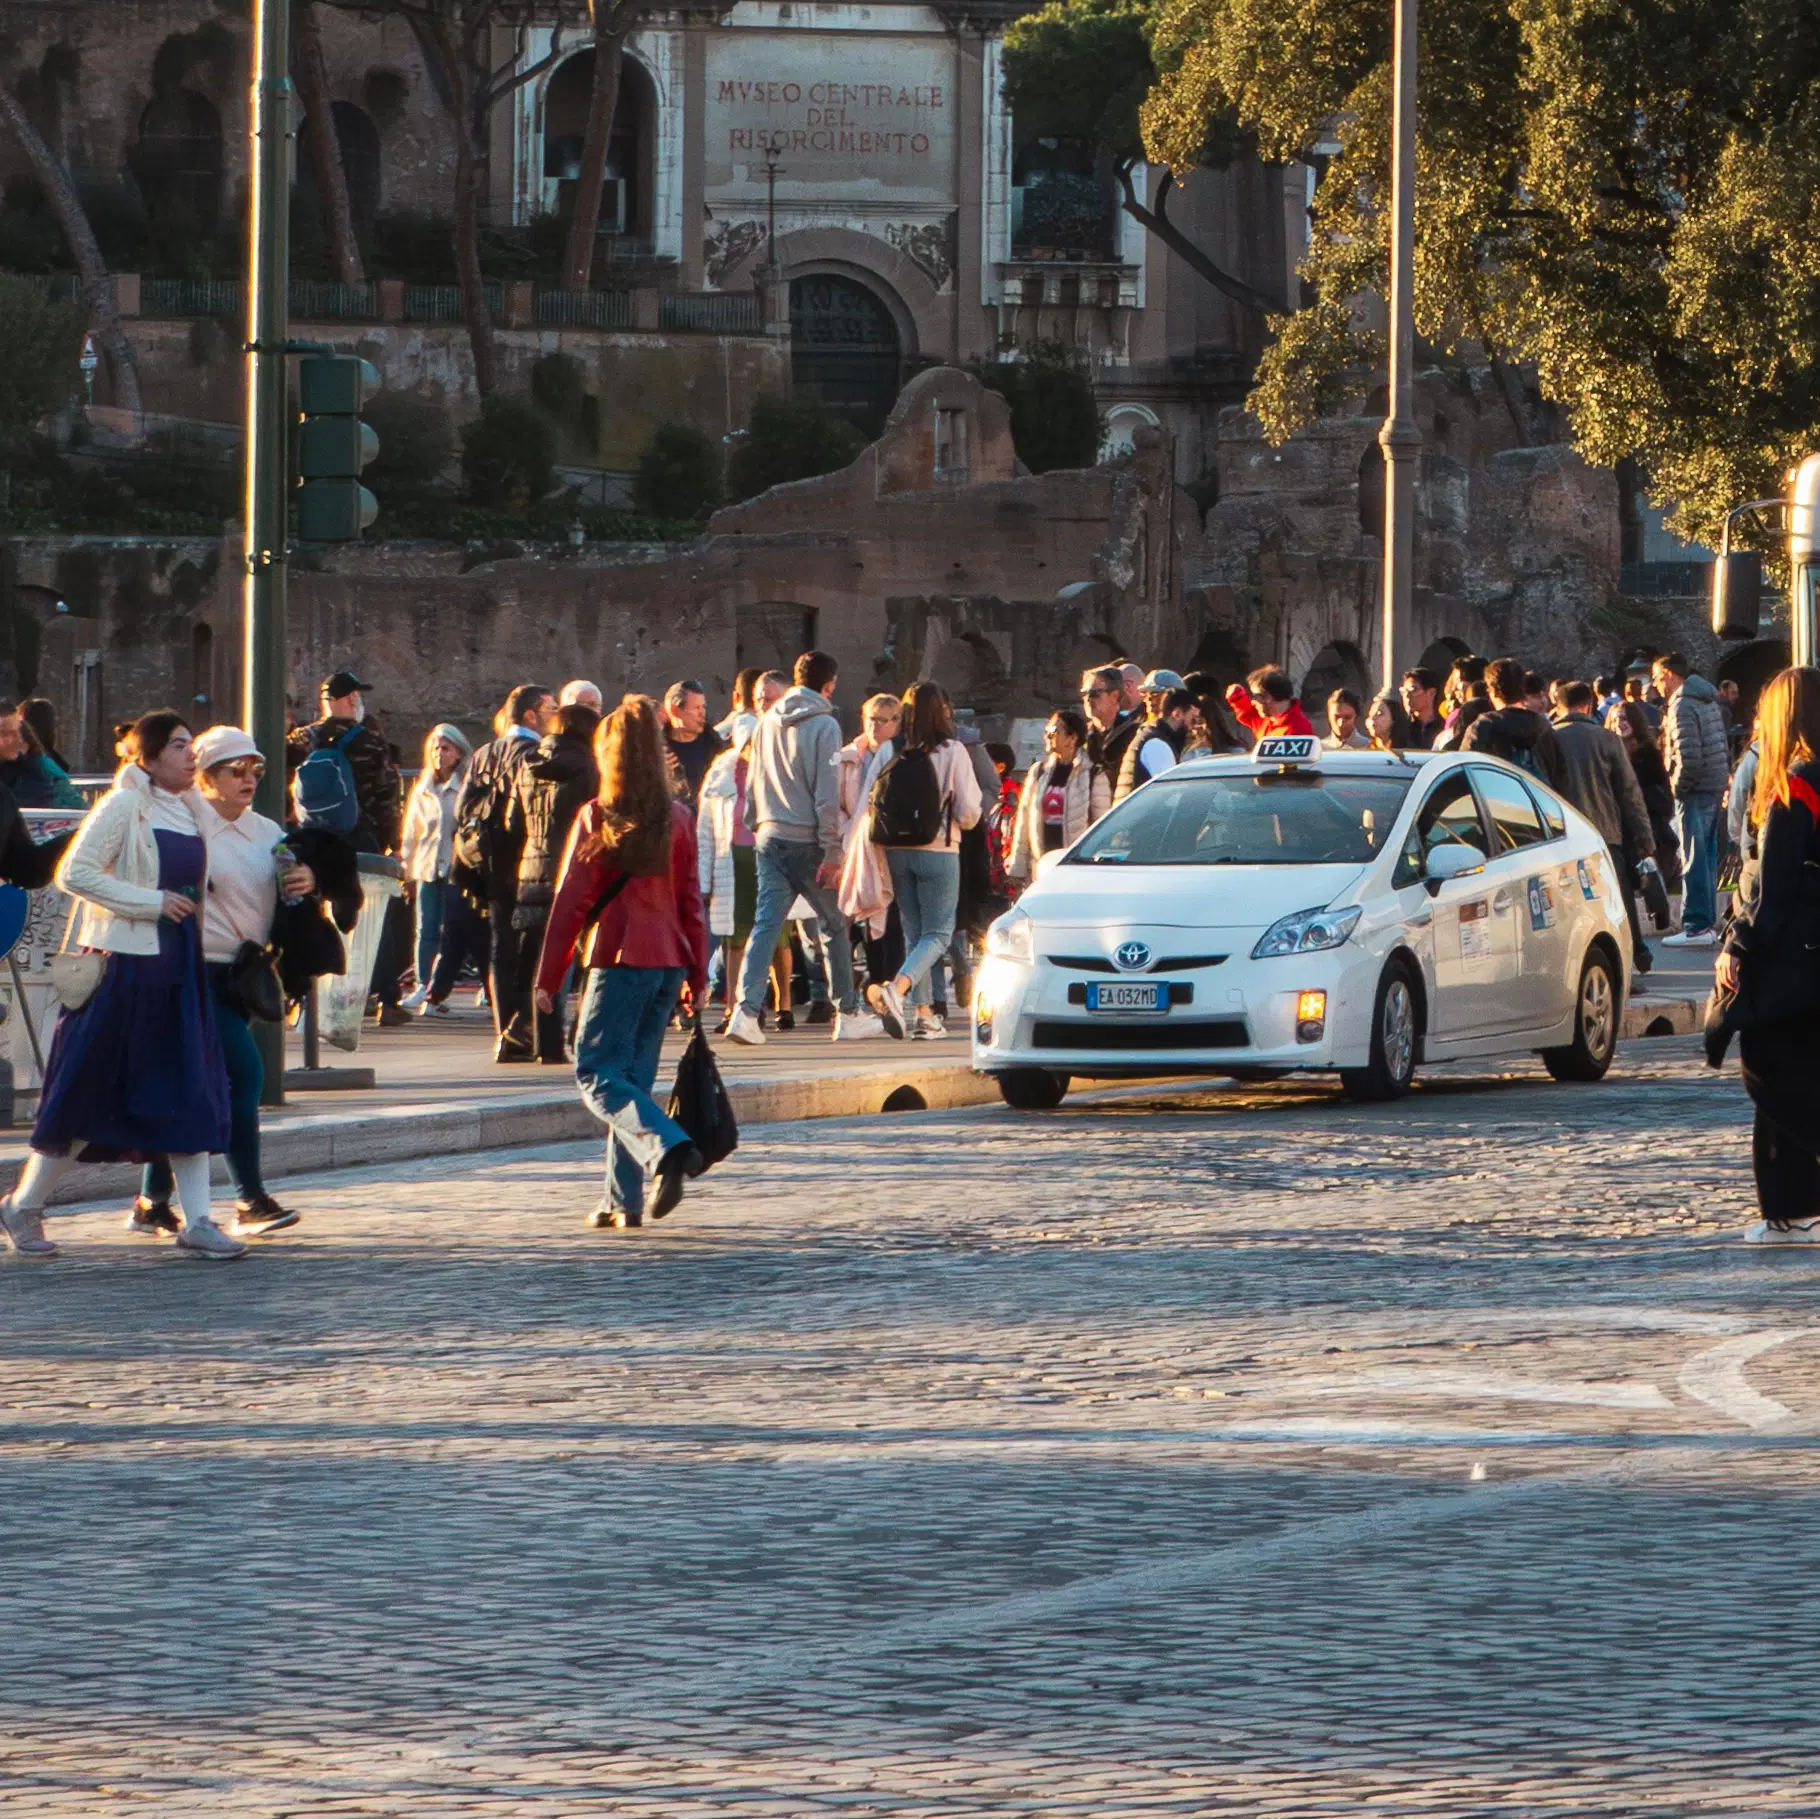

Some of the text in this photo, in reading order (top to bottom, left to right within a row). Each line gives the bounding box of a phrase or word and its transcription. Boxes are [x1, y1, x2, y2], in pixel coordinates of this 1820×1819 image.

[808, 83, 943, 108] CENTRALE
[806, 108, 855, 128] DEL
[728, 128, 930, 154] RISORCIMENTO
[1262, 741, 1309, 755] TAXI
[1099, 988, 1115, 1005] EA
